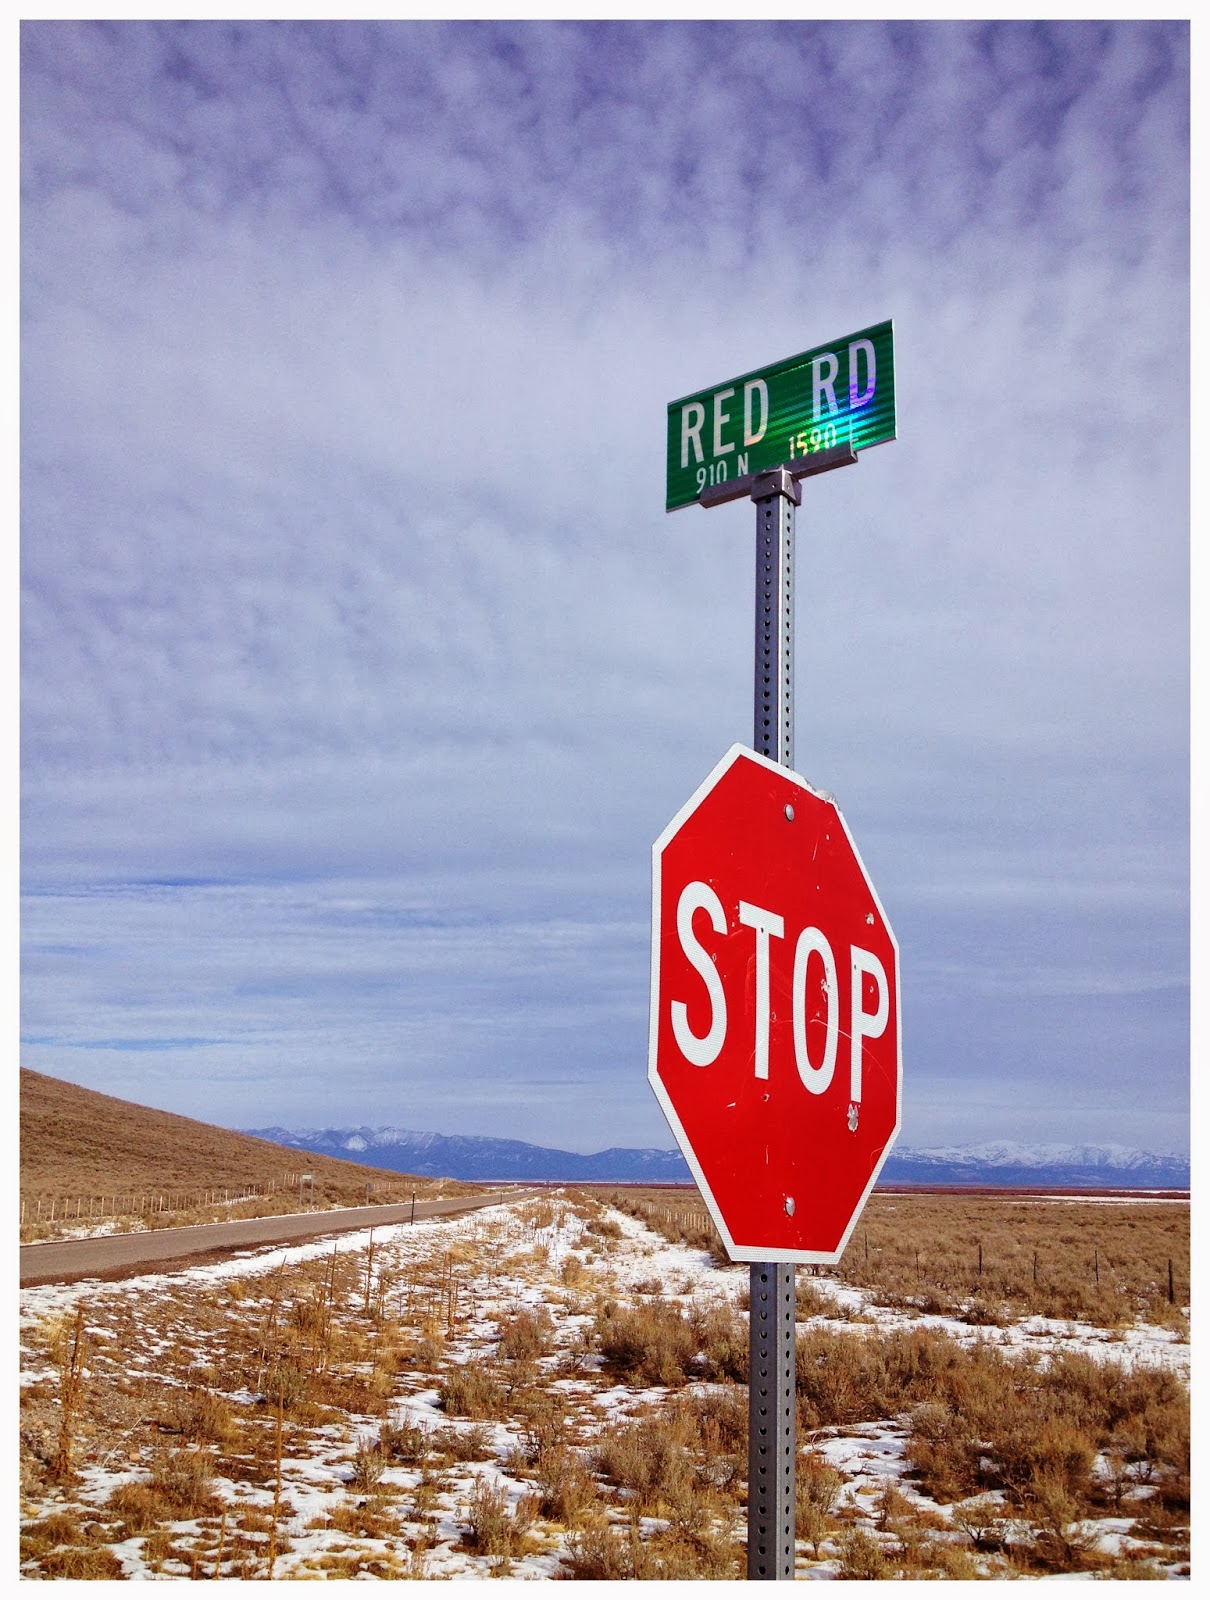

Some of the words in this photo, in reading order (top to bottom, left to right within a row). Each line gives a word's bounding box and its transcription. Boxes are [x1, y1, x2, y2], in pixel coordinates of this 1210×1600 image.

[680, 377, 769, 469] RED
[811, 338, 877, 422] RD
[696, 459, 728, 494] 910
[737, 452, 749, 477] N
[788, 423, 837, 460] 1590
[671, 881, 890, 1103] STOP
